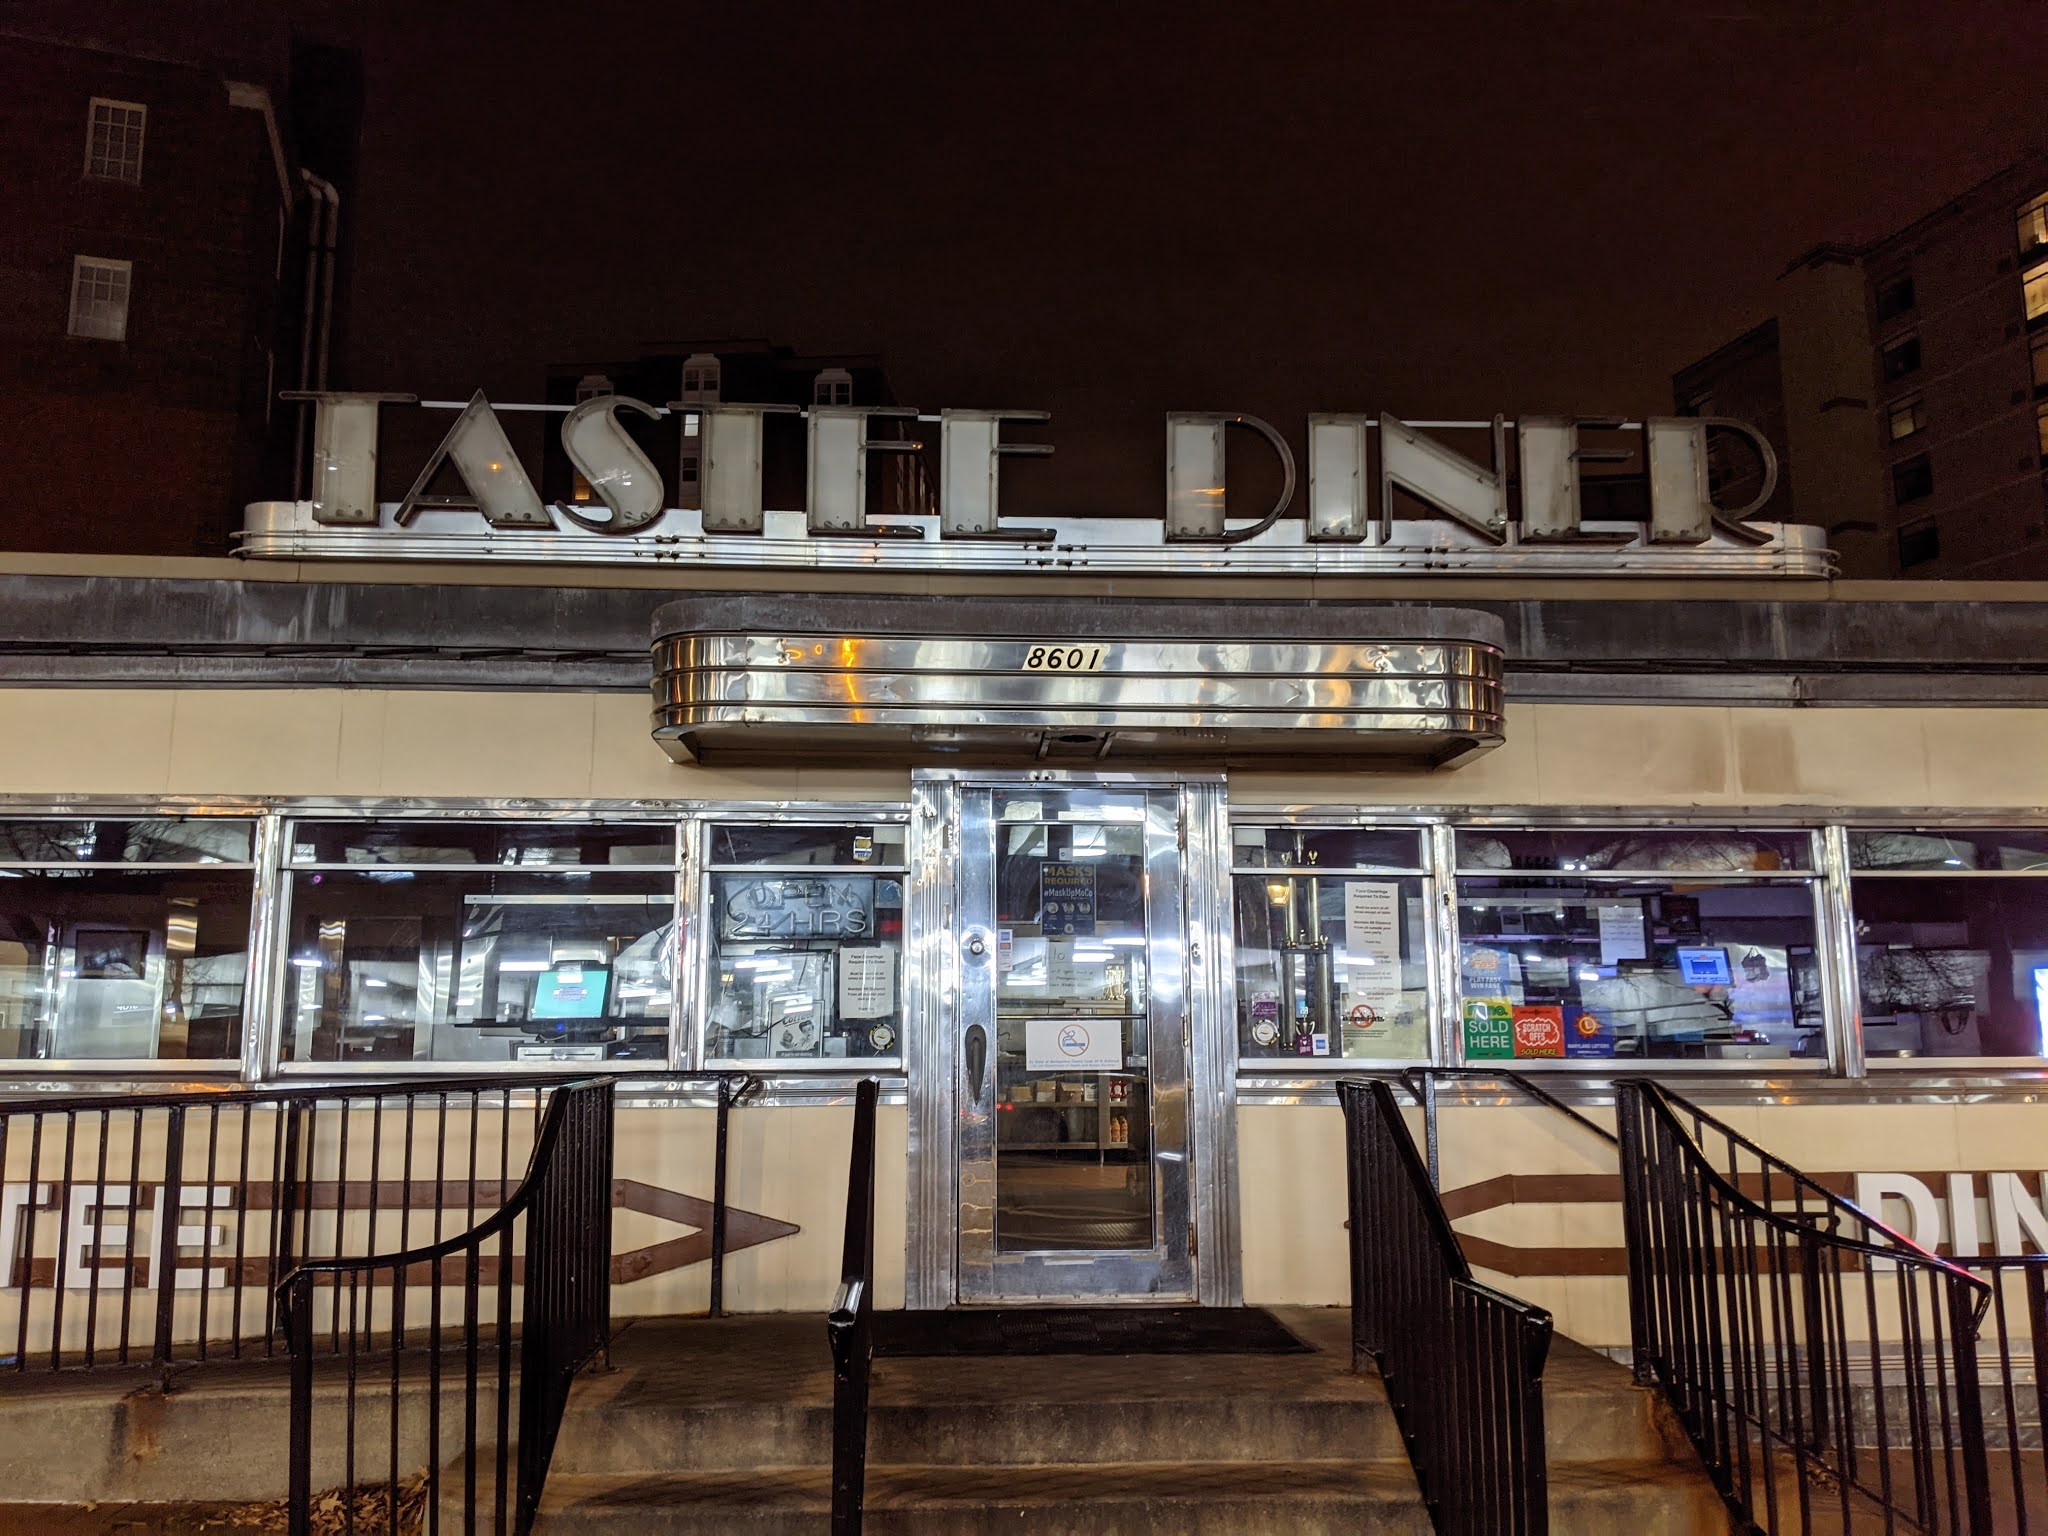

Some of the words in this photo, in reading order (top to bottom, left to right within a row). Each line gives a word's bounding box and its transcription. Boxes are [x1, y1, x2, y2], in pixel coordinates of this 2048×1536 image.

[279, 388, 1057, 540] TASTEE
[1166, 411, 1777, 545] DINER
[1028, 648, 1100, 669] 8601
[1045, 866, 1093, 876] MASKS
[747, 883, 852, 908] OPEN
[1044, 888, 1093, 900] #MaskUpMoCo
[731, 911, 769, 935] 24
[790, 909, 866, 935] HRS
[1469, 1021, 1509, 1033] SOLD
[1522, 1023, 1551, 1033] SCRATCH
[1470, 1036, 1510, 1049] HERE
[1529, 1032, 1546, 1042] OFFS
